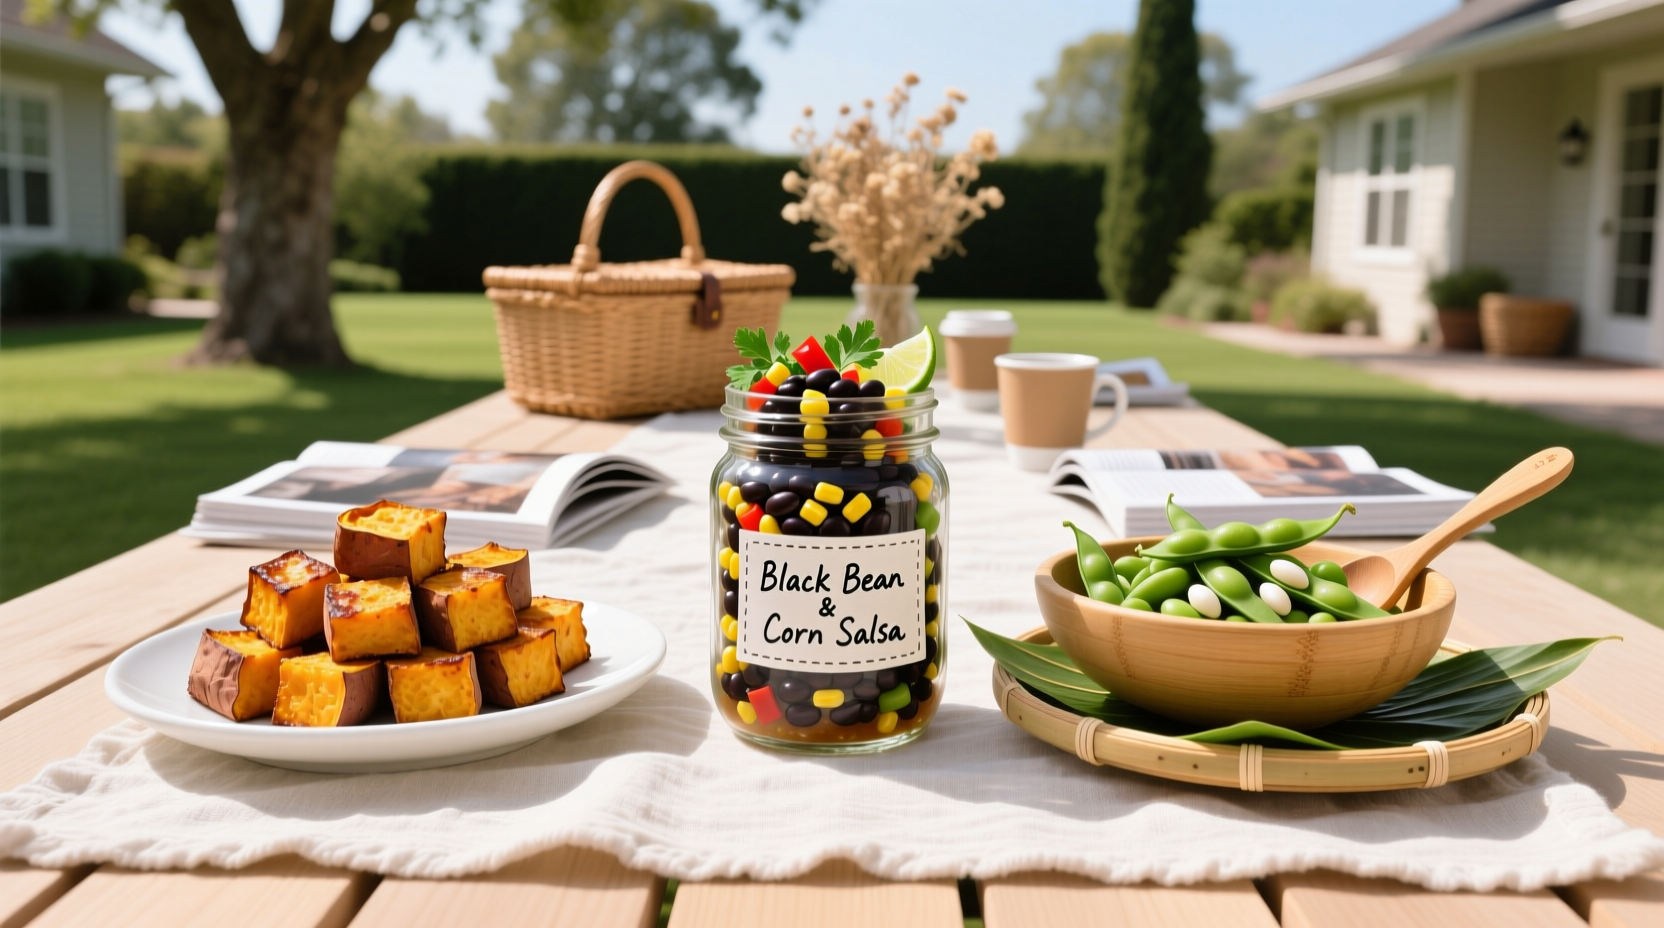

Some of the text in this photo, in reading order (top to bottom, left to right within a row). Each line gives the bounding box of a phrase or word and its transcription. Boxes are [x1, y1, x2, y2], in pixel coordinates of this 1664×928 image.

[760, 560, 905, 594] Black Bean
[818, 596, 837, 617] &
[763, 612, 906, 647] Corn Salsa
